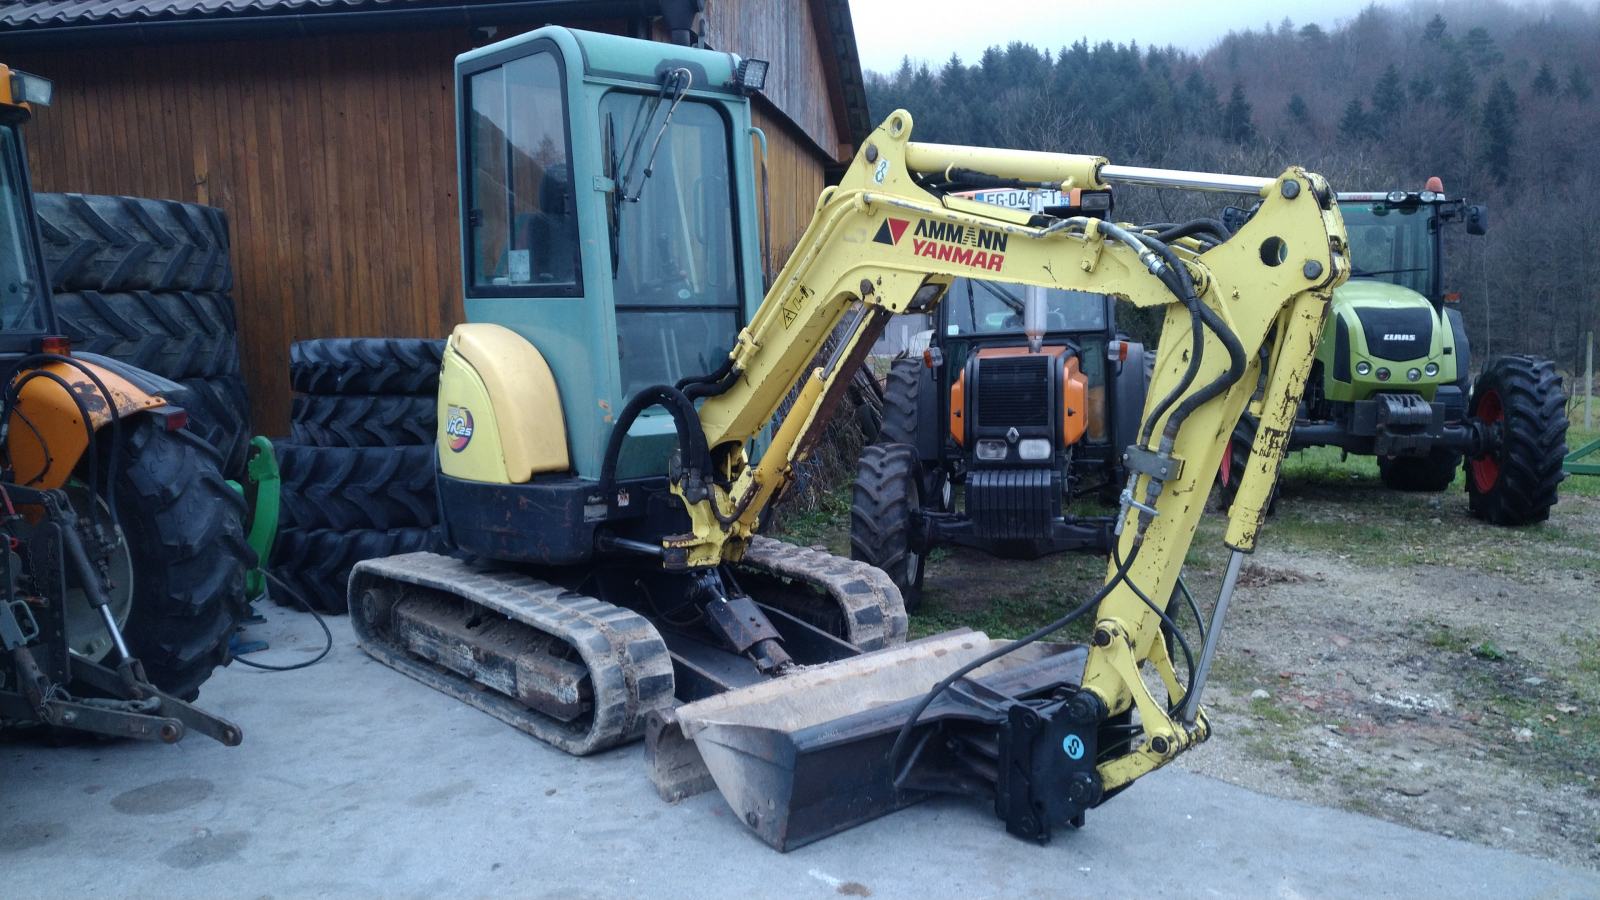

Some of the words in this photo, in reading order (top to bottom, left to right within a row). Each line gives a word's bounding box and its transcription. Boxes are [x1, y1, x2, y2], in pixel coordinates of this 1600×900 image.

[913, 218, 1009, 253] AMMANN
[912, 238, 1005, 272] YANMAR
[1384, 333, 1416, 342] CLAAS
